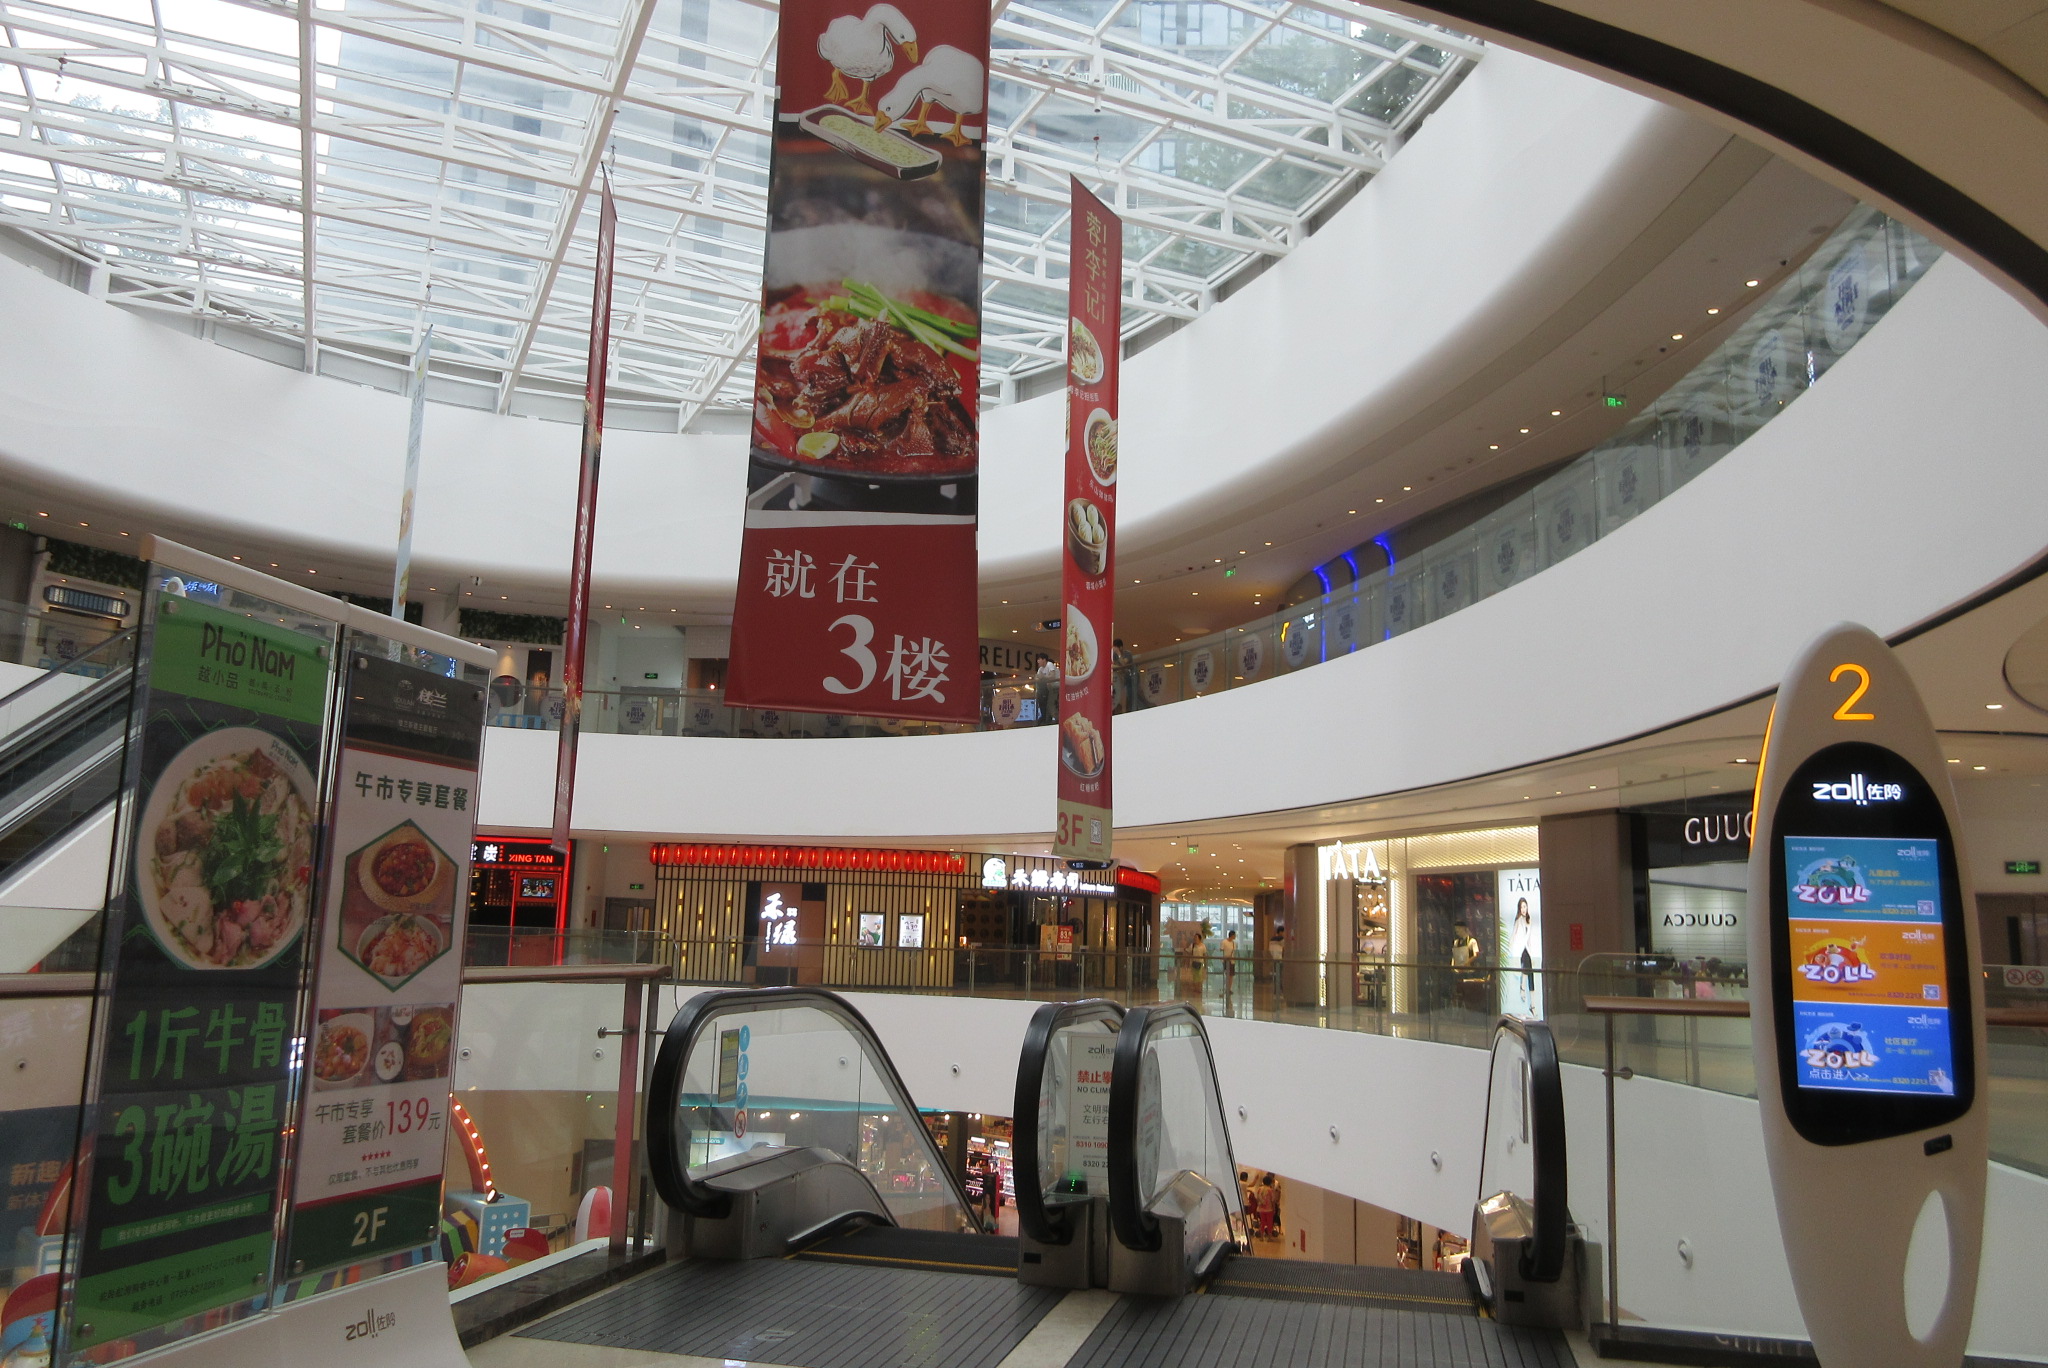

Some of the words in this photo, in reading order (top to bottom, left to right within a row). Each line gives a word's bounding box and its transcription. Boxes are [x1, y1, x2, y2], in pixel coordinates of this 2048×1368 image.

[764, 549, 879, 603] 就在
[822, 614, 950, 703] 3楼
[979, 643, 1040, 673] RELIS
[1828, 662, 1875, 721] 2
[355, 771, 468, 811] 午市专享套餐
[1058, 811, 1084, 847] 3F
[508, 854, 532, 863] XING
[534, 855, 553, 863] TAN
[1805, 963, 1875, 983] ZOLL
[126, 1002, 287, 1080] 1斤牛骨
[1806, 1049, 1875, 1069] ZOLL
[315, 1099, 374, 1124] 午市专享
[342, 1120, 386, 1144] 套餐价
[1083, 1160, 1100, 1168] 8320
[351, 1206, 389, 1247] 2F
